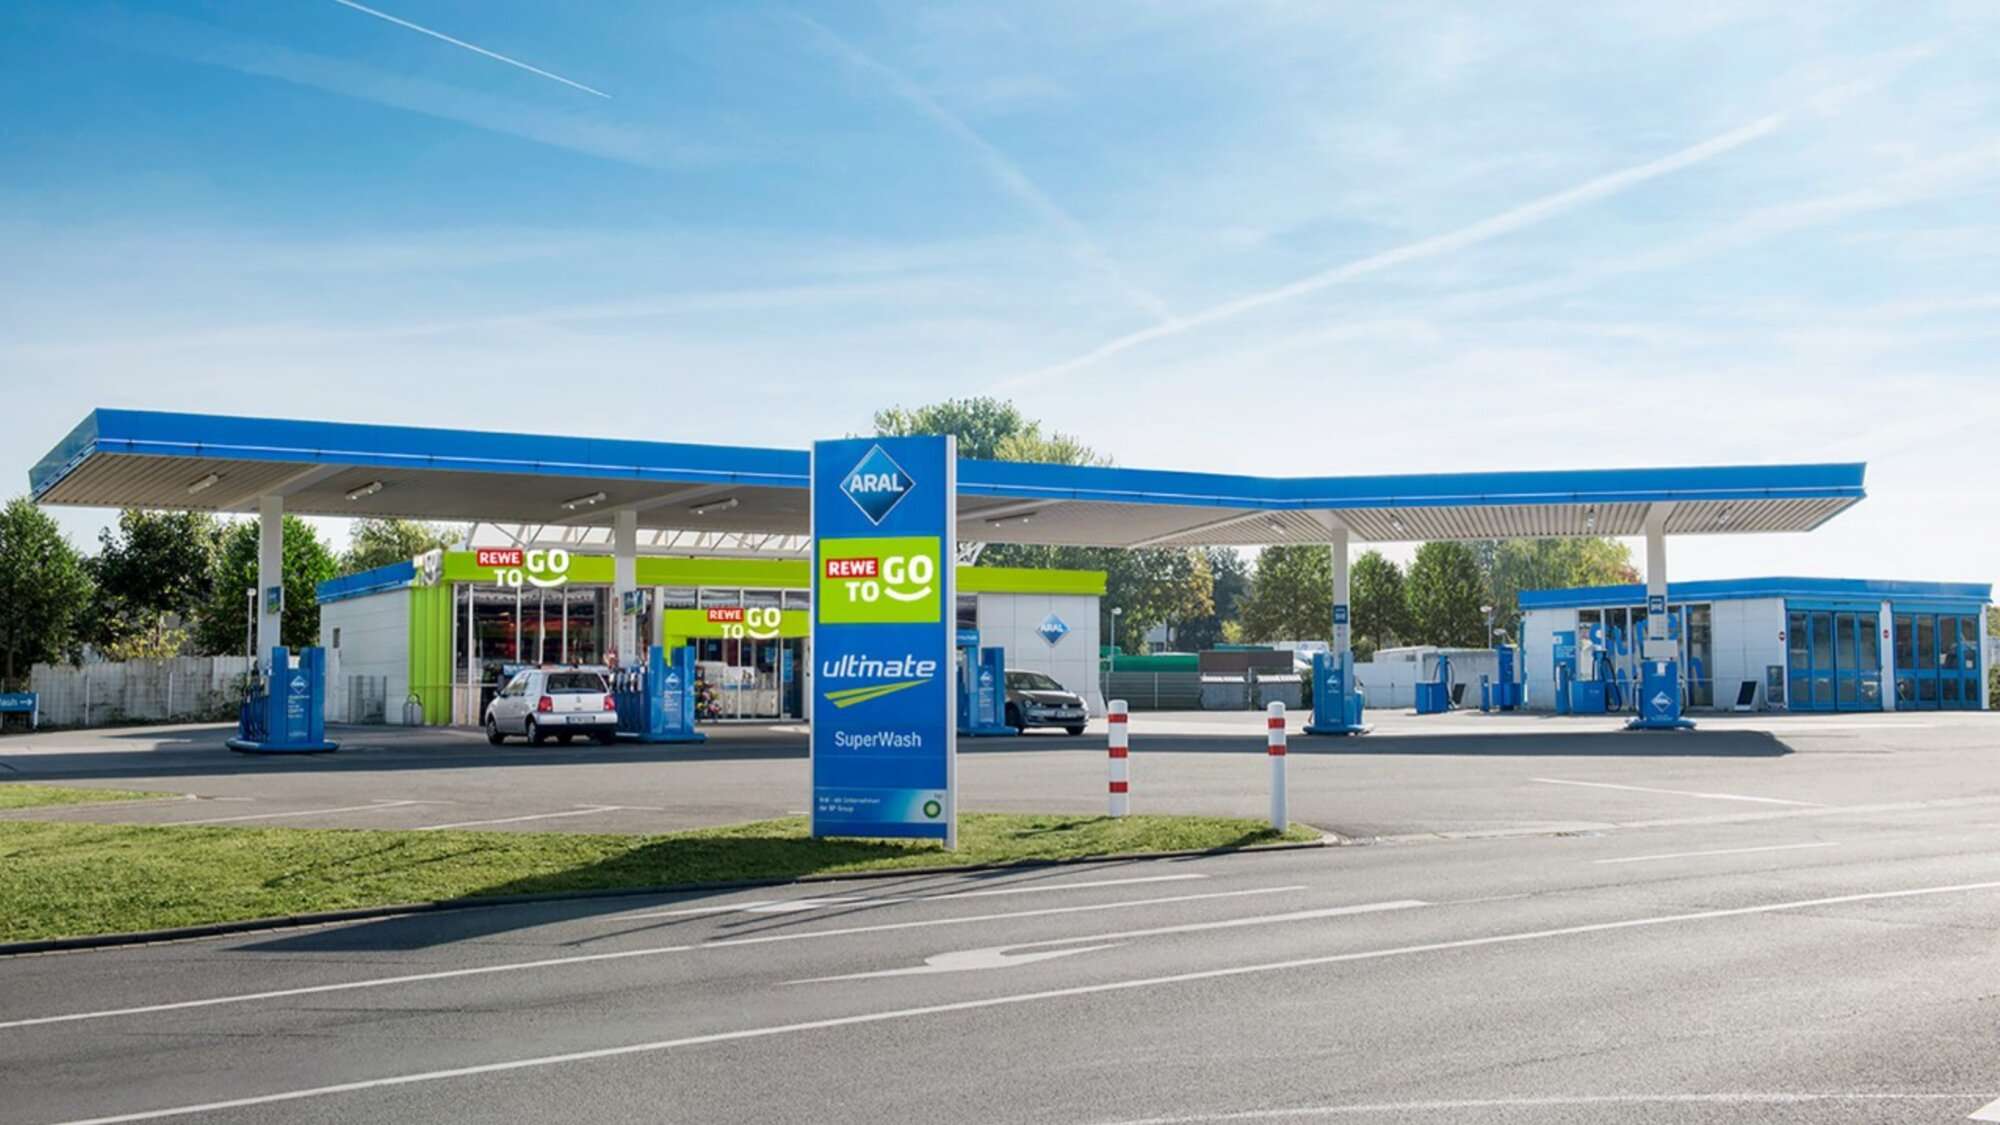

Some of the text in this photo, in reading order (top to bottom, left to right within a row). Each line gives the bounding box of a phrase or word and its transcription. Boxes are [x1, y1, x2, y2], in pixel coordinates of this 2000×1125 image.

[849, 473, 904, 493] ARAL
[480, 549, 569, 573] REWE GO
[828, 555, 934, 584] REWE GO
[494, 569, 523, 587] TO
[845, 582, 880, 602] TO
[709, 607, 781, 627] REWE GO
[722, 624, 744, 639] TO
[1040, 623, 1064, 633] ARAL
[823, 653, 937, 678] ultimate
[834, 730, 922, 749] SuperWash
